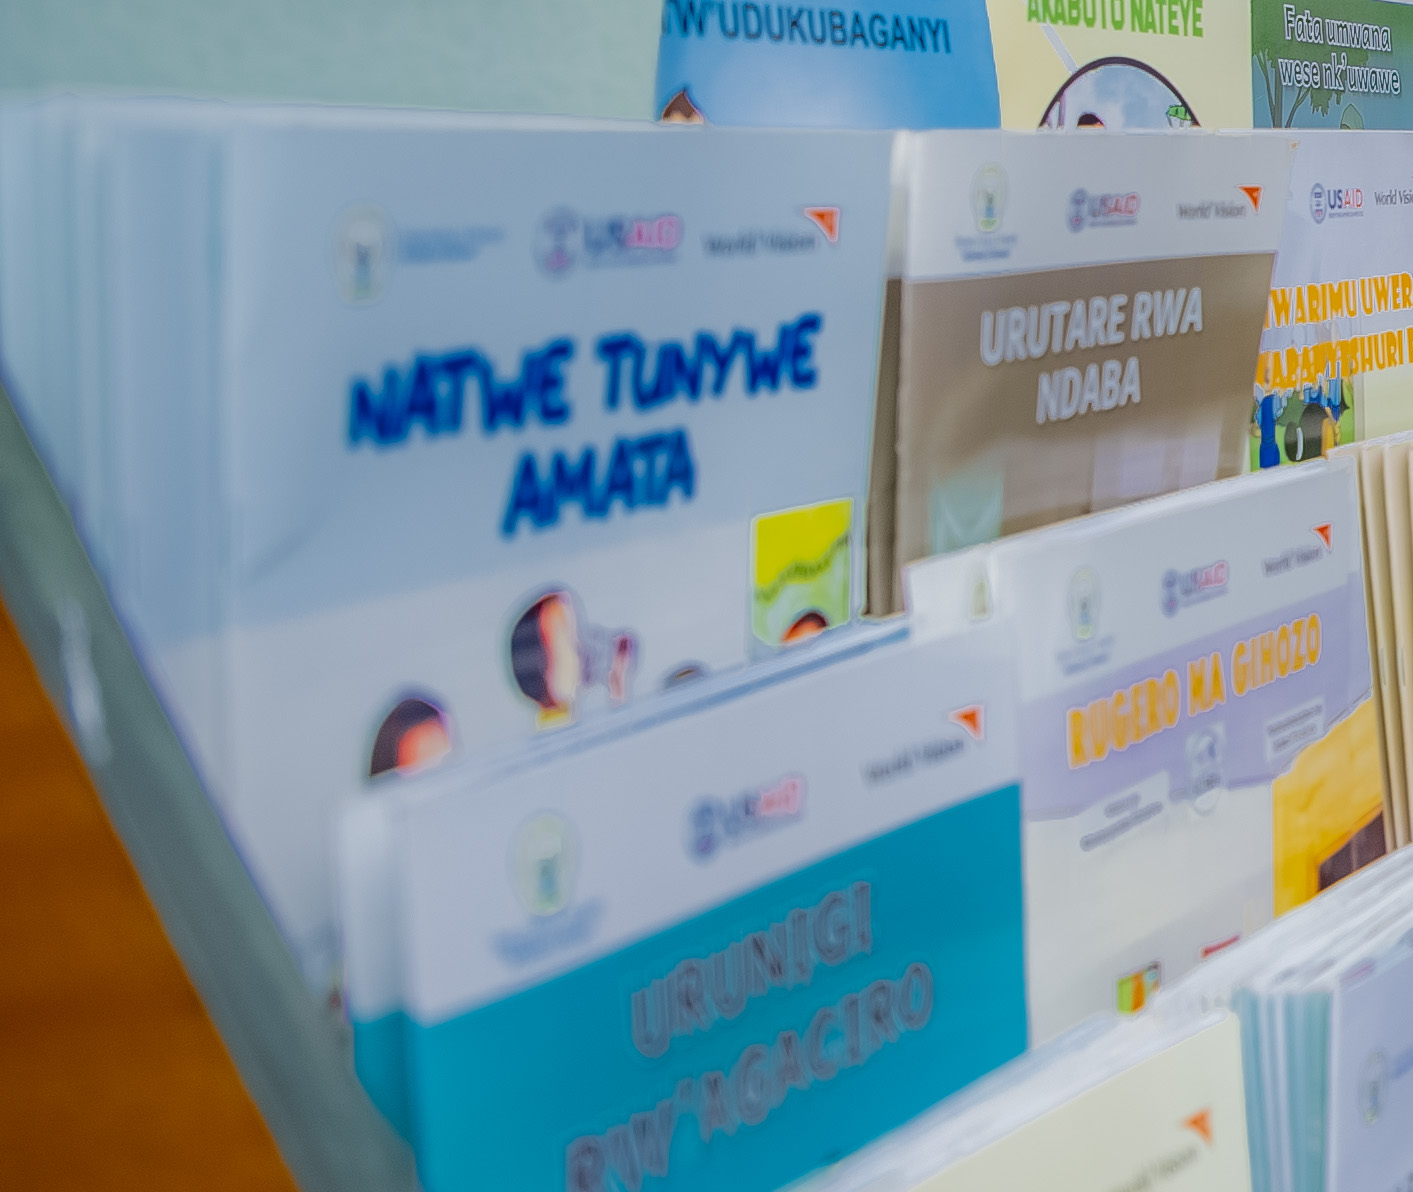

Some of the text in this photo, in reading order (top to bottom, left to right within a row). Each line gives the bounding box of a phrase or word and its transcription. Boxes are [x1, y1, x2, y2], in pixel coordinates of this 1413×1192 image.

[1283, 3, 1391, 52] Fata umwana
[1278, 58, 1319, 88] wese
[1328, 188, 1363, 209] USAID
[1374, 189, 1397, 205] World
[980, 287, 1203, 366] URUTARE RWA
[346, 311, 824, 451] NATWE TUNYWE
[1036, 356, 1141, 424] NDABA
[498, 426, 697, 541] AMATA
[1067, 669, 1181, 770] RUGERO
[1232, 613, 1322, 697] GIHOZO
